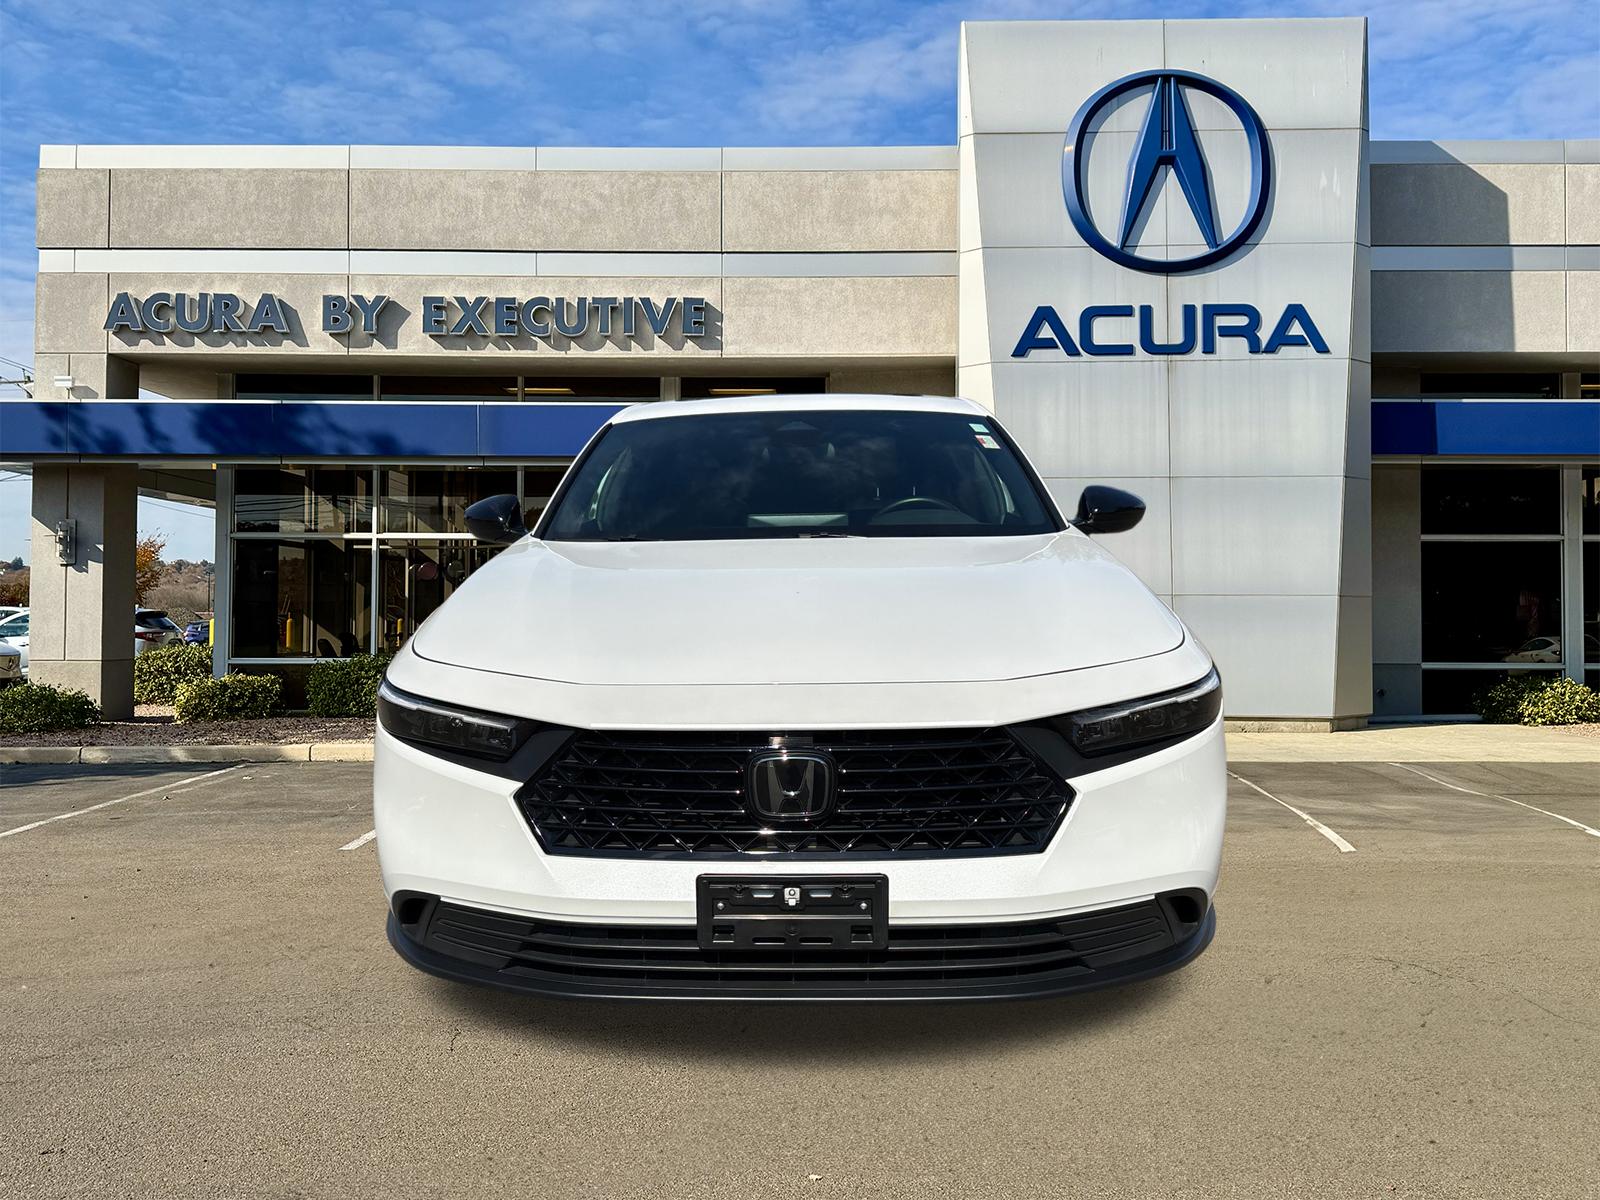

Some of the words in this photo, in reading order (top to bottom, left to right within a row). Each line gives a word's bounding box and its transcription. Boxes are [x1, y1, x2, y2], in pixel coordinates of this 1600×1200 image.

[103, 291, 290, 333] ACURA
[322, 294, 390, 335] BY
[421, 296, 706, 336] EXECUTIVE
[1010, 303, 1332, 357] ACURA
